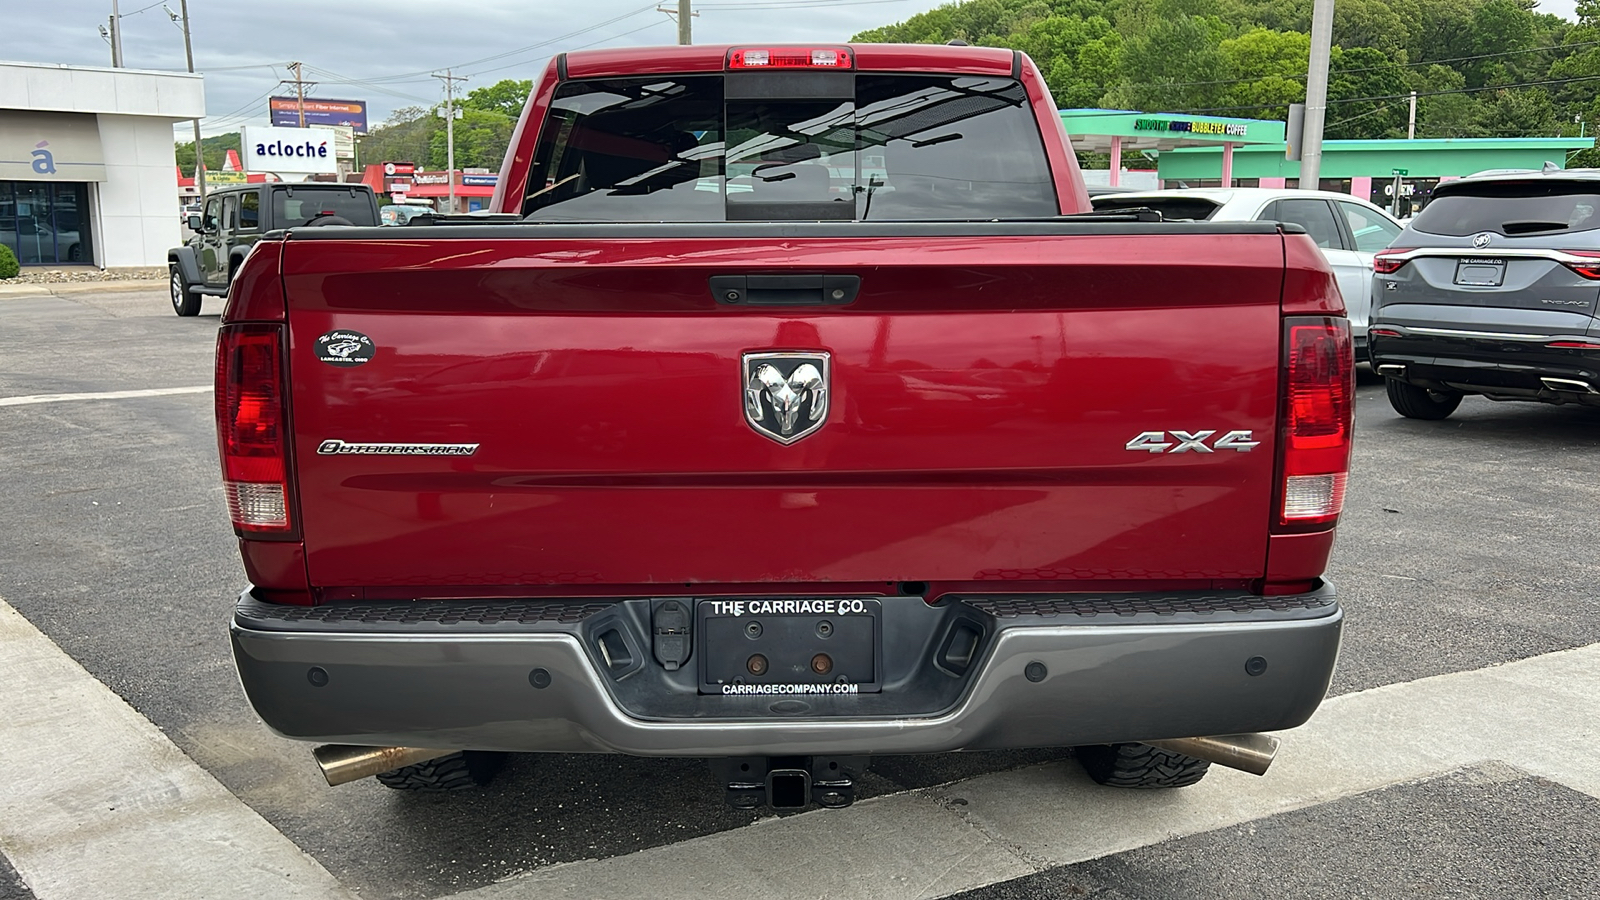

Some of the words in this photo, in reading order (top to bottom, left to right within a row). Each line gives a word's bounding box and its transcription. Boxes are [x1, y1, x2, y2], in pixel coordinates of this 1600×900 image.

[1226, 124, 1247, 136] COFFEE
[256, 140, 327, 158] acloché
[1384, 184, 1415, 196] OEN
[331, 332, 359, 342] Carriage
[1125, 430, 1261, 453] 4X4
[711, 600, 745, 615] THE
[749, 600, 835, 615] CARRIAGE
[838, 599, 868, 615] CO.
[722, 684, 859, 695] CARRIAGECOMPANY.COM
